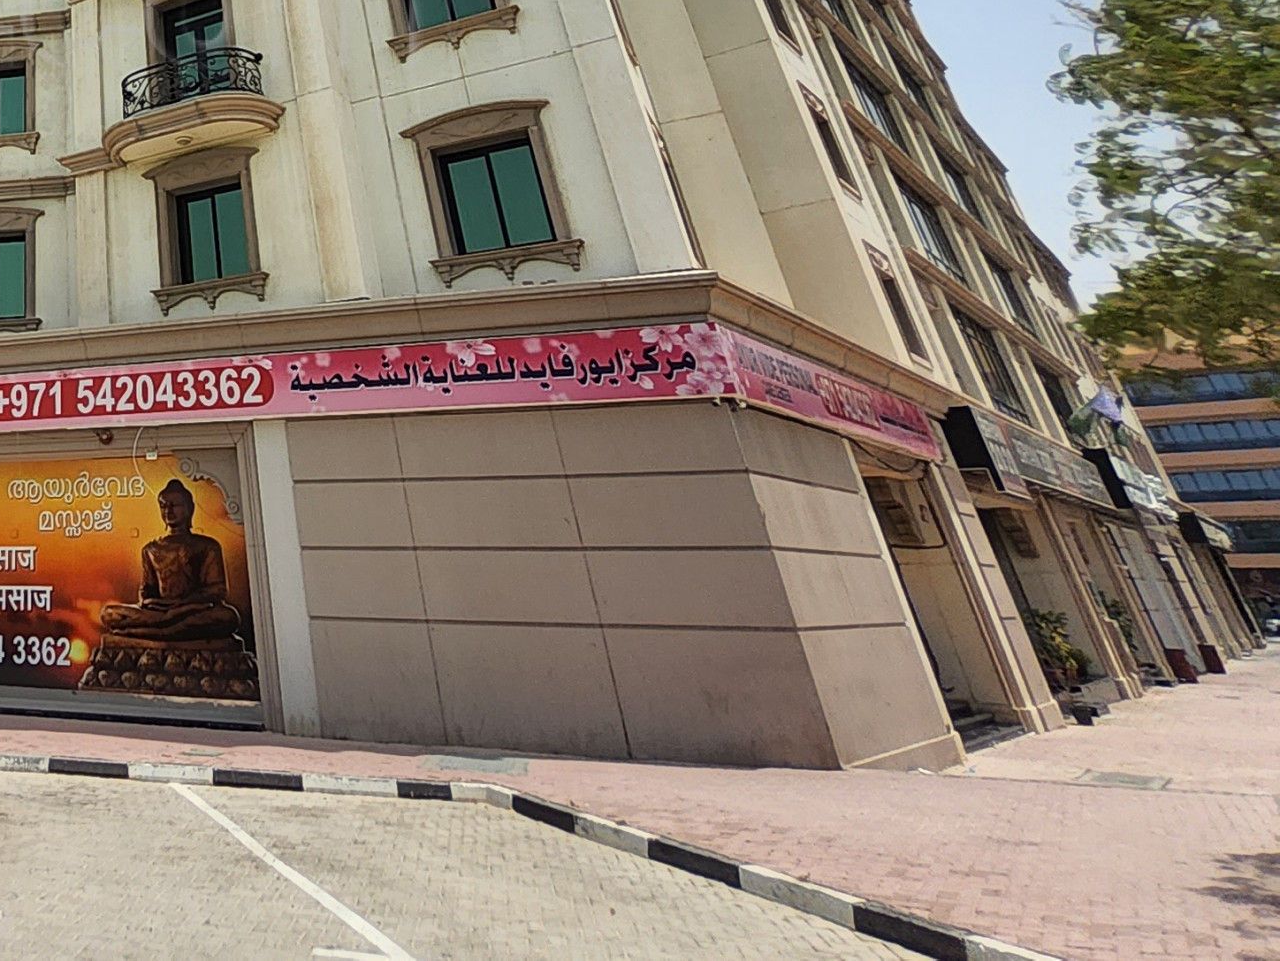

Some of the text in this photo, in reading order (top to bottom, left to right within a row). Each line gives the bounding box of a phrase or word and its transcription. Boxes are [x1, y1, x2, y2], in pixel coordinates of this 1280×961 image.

[290, 354, 418, 401] الشخصية
[422, 355, 516, 394] للعناية
[520, 343, 575, 390] فايد
[626, 344, 696, 381] مركز
[76, 366, 263, 414] 542043362
[12, 636, 71, 666] 3362
